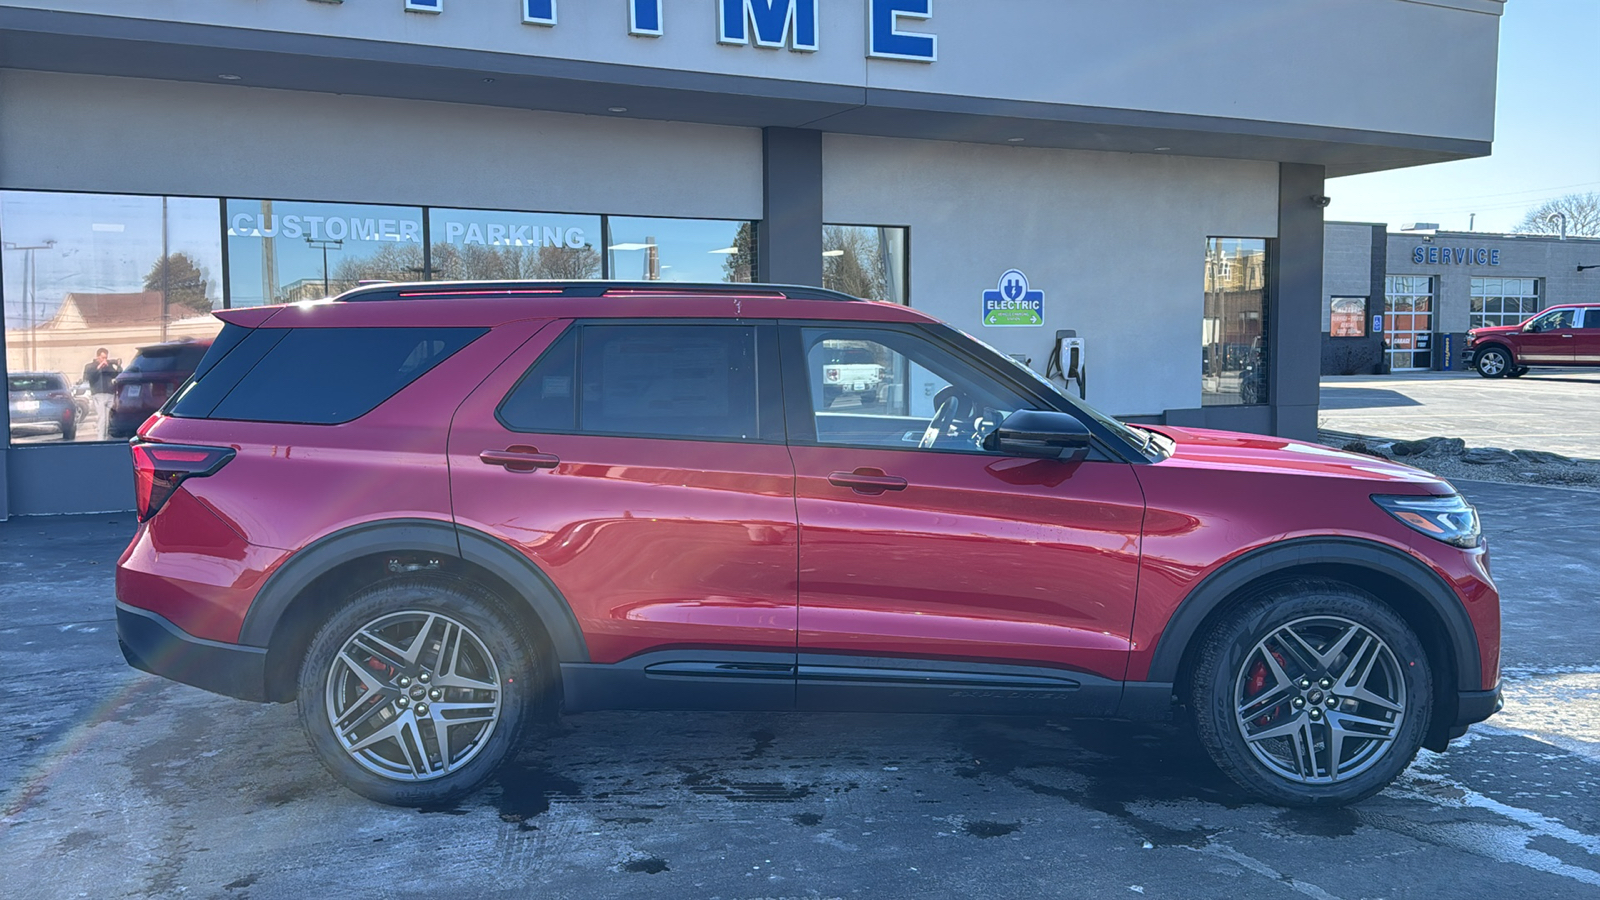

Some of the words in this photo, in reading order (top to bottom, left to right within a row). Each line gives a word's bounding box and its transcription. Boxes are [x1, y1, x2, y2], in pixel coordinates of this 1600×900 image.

[231, 212, 421, 243] CUSTOMER
[445, 221, 586, 249] PARKING
[1413, 246, 1500, 265] SERVICE
[987, 300, 1040, 310] ELECTRIC
